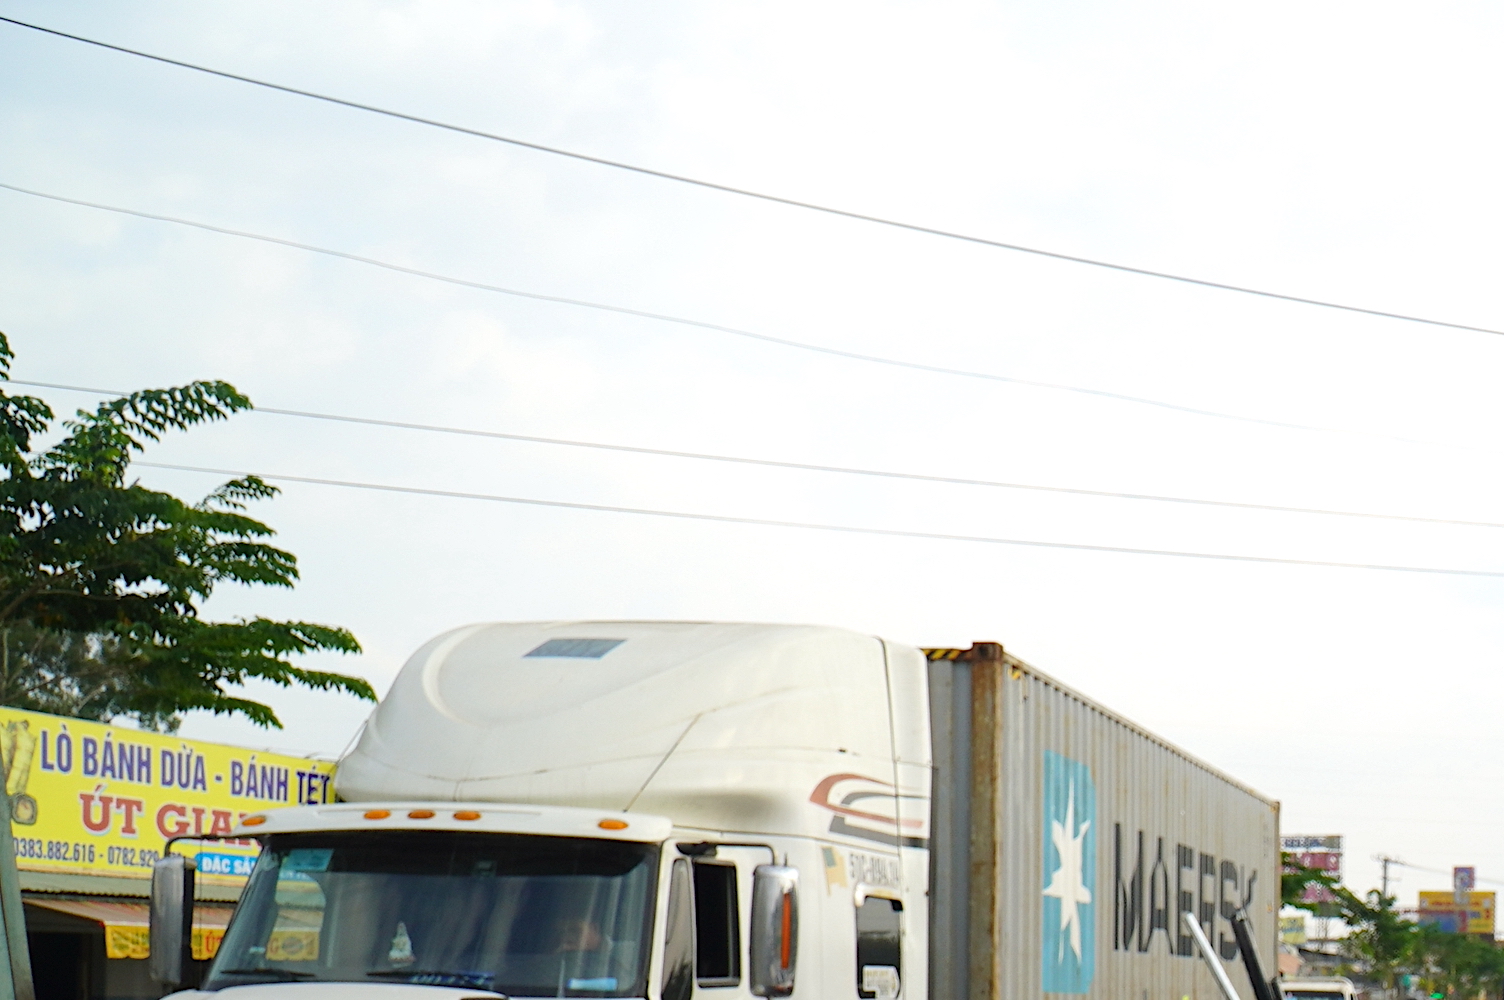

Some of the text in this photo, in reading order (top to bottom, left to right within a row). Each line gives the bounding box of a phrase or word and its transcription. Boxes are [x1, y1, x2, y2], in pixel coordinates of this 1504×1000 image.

[41, 724, 72, 773] LÒ
[83, 732, 151, 784] BÁNH
[161, 744, 207, 791] DỪA
[231, 755, 289, 802] BÁNH
[80, 783, 143, 835] ÚT
